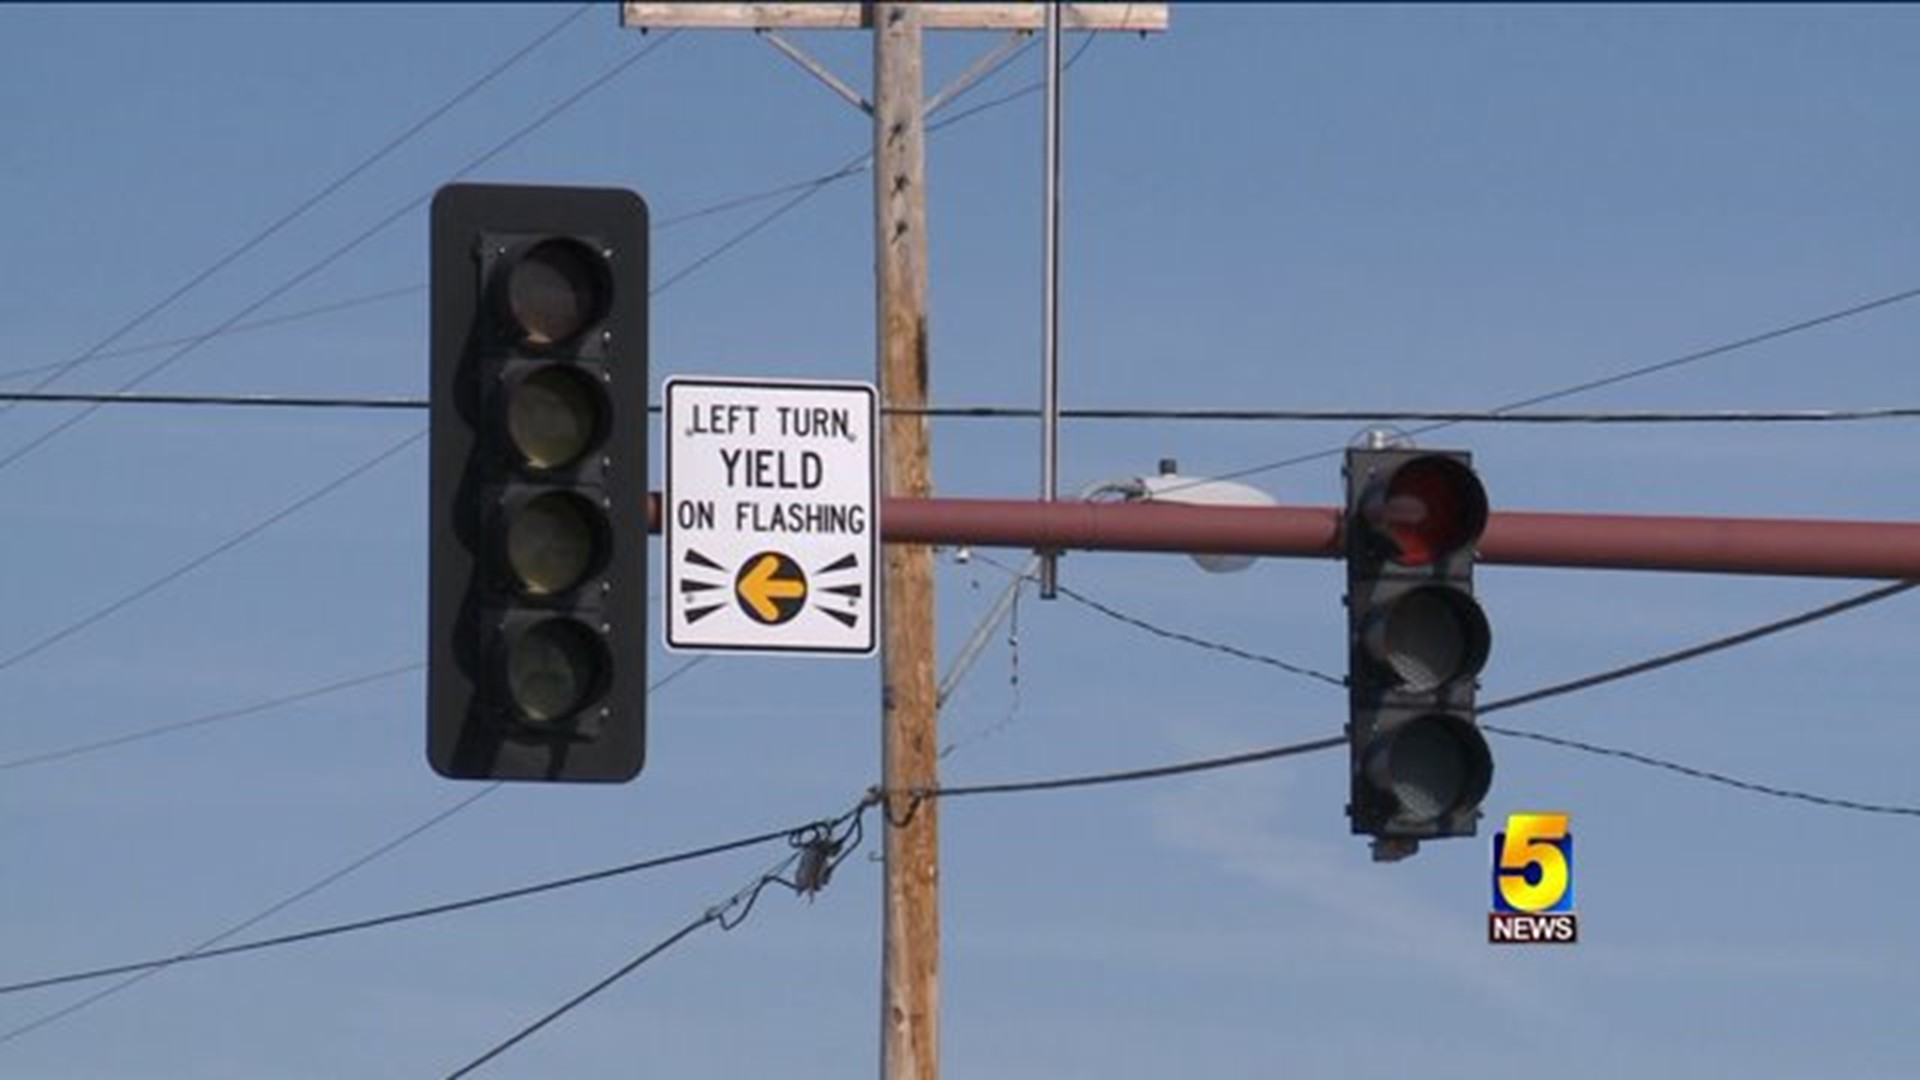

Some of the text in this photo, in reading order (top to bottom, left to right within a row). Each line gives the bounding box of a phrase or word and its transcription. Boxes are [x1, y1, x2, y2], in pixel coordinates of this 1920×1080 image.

[692, 404, 849, 438] LEFT TURN
[720, 448, 824, 489] YIELD
[678, 500, 865, 534] ON FLASHING
